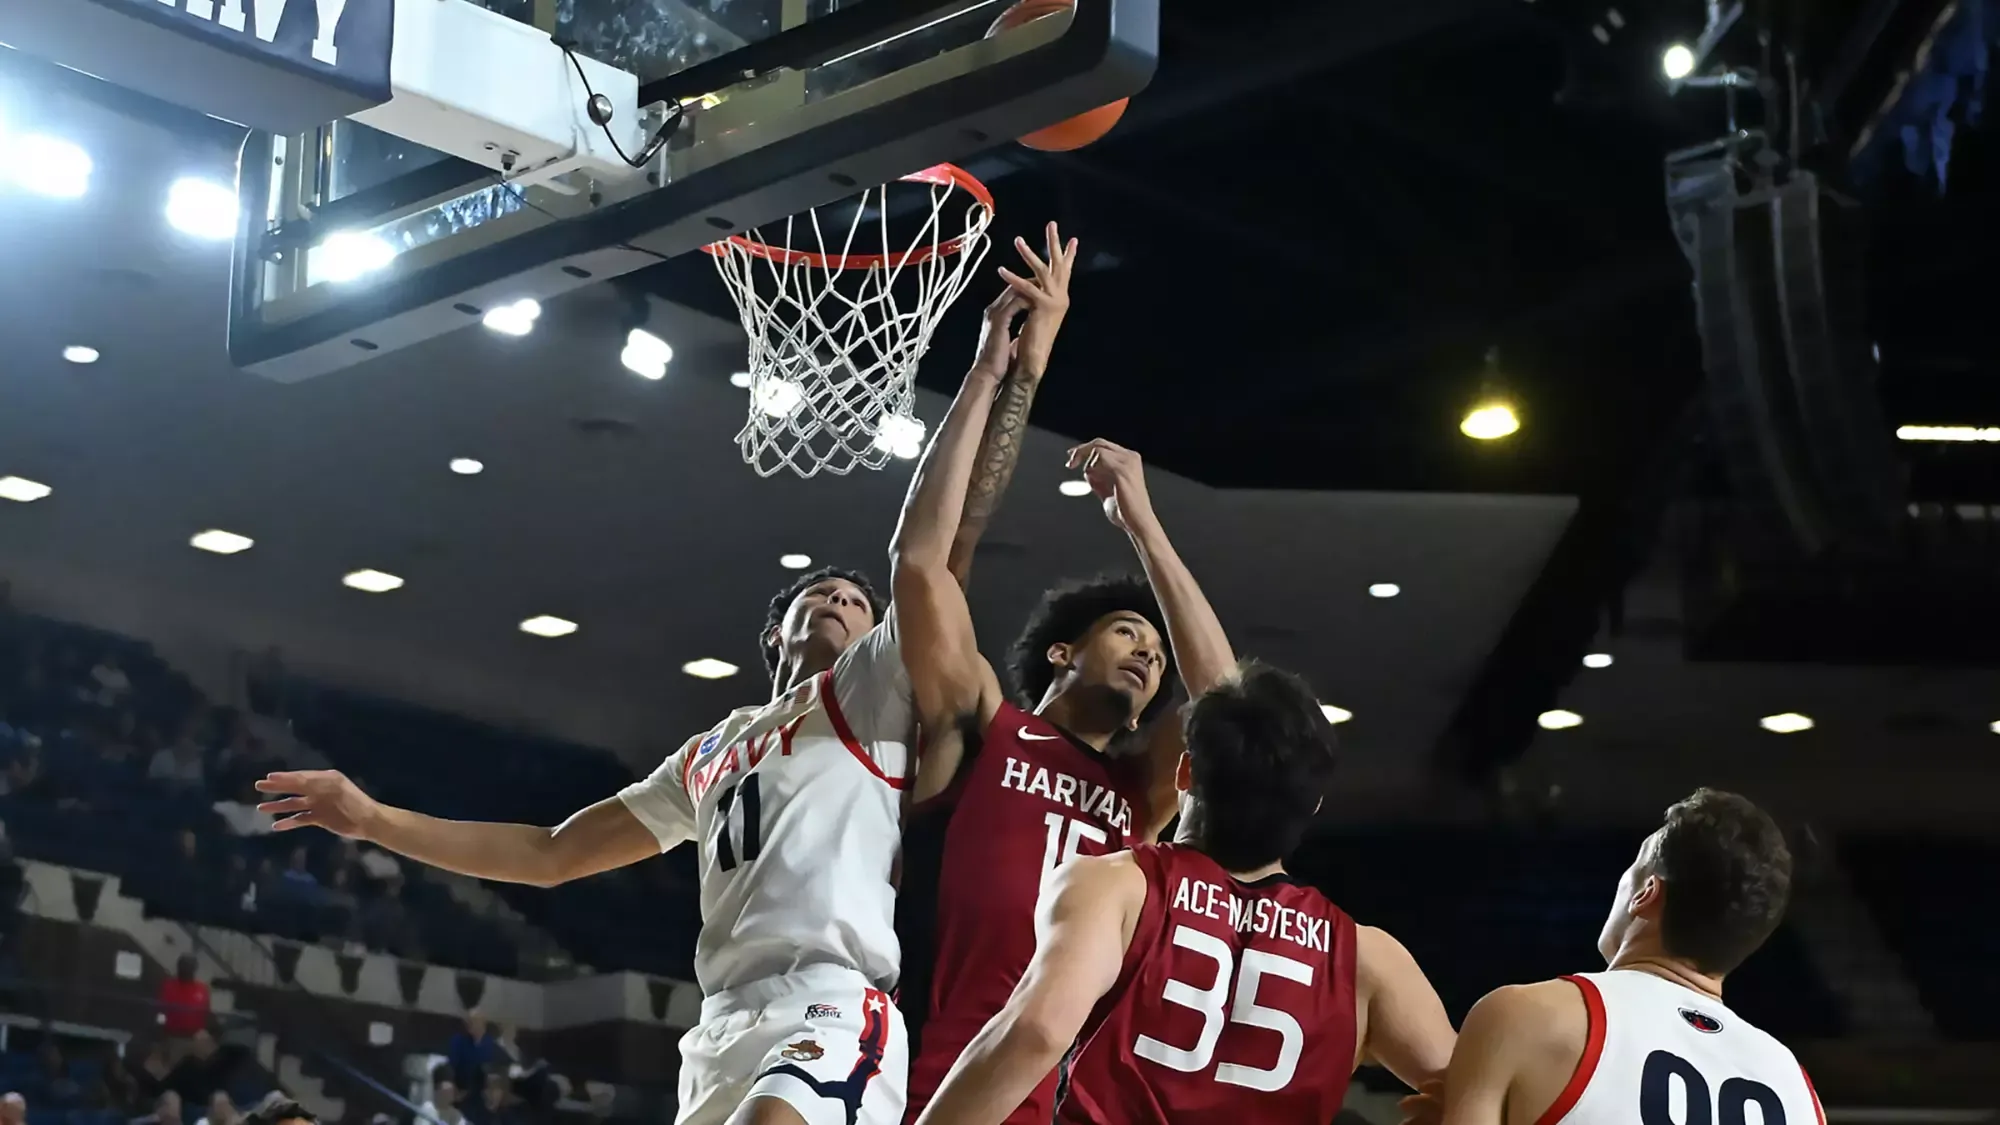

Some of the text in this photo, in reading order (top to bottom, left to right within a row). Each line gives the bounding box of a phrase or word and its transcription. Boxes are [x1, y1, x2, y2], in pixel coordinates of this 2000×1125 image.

[694, 714, 807, 802] NAVY
[717, 772, 761, 872] 11
[1173, 877, 1331, 953] ACE-NASTESKI
[1133, 925, 1314, 1093] 35
